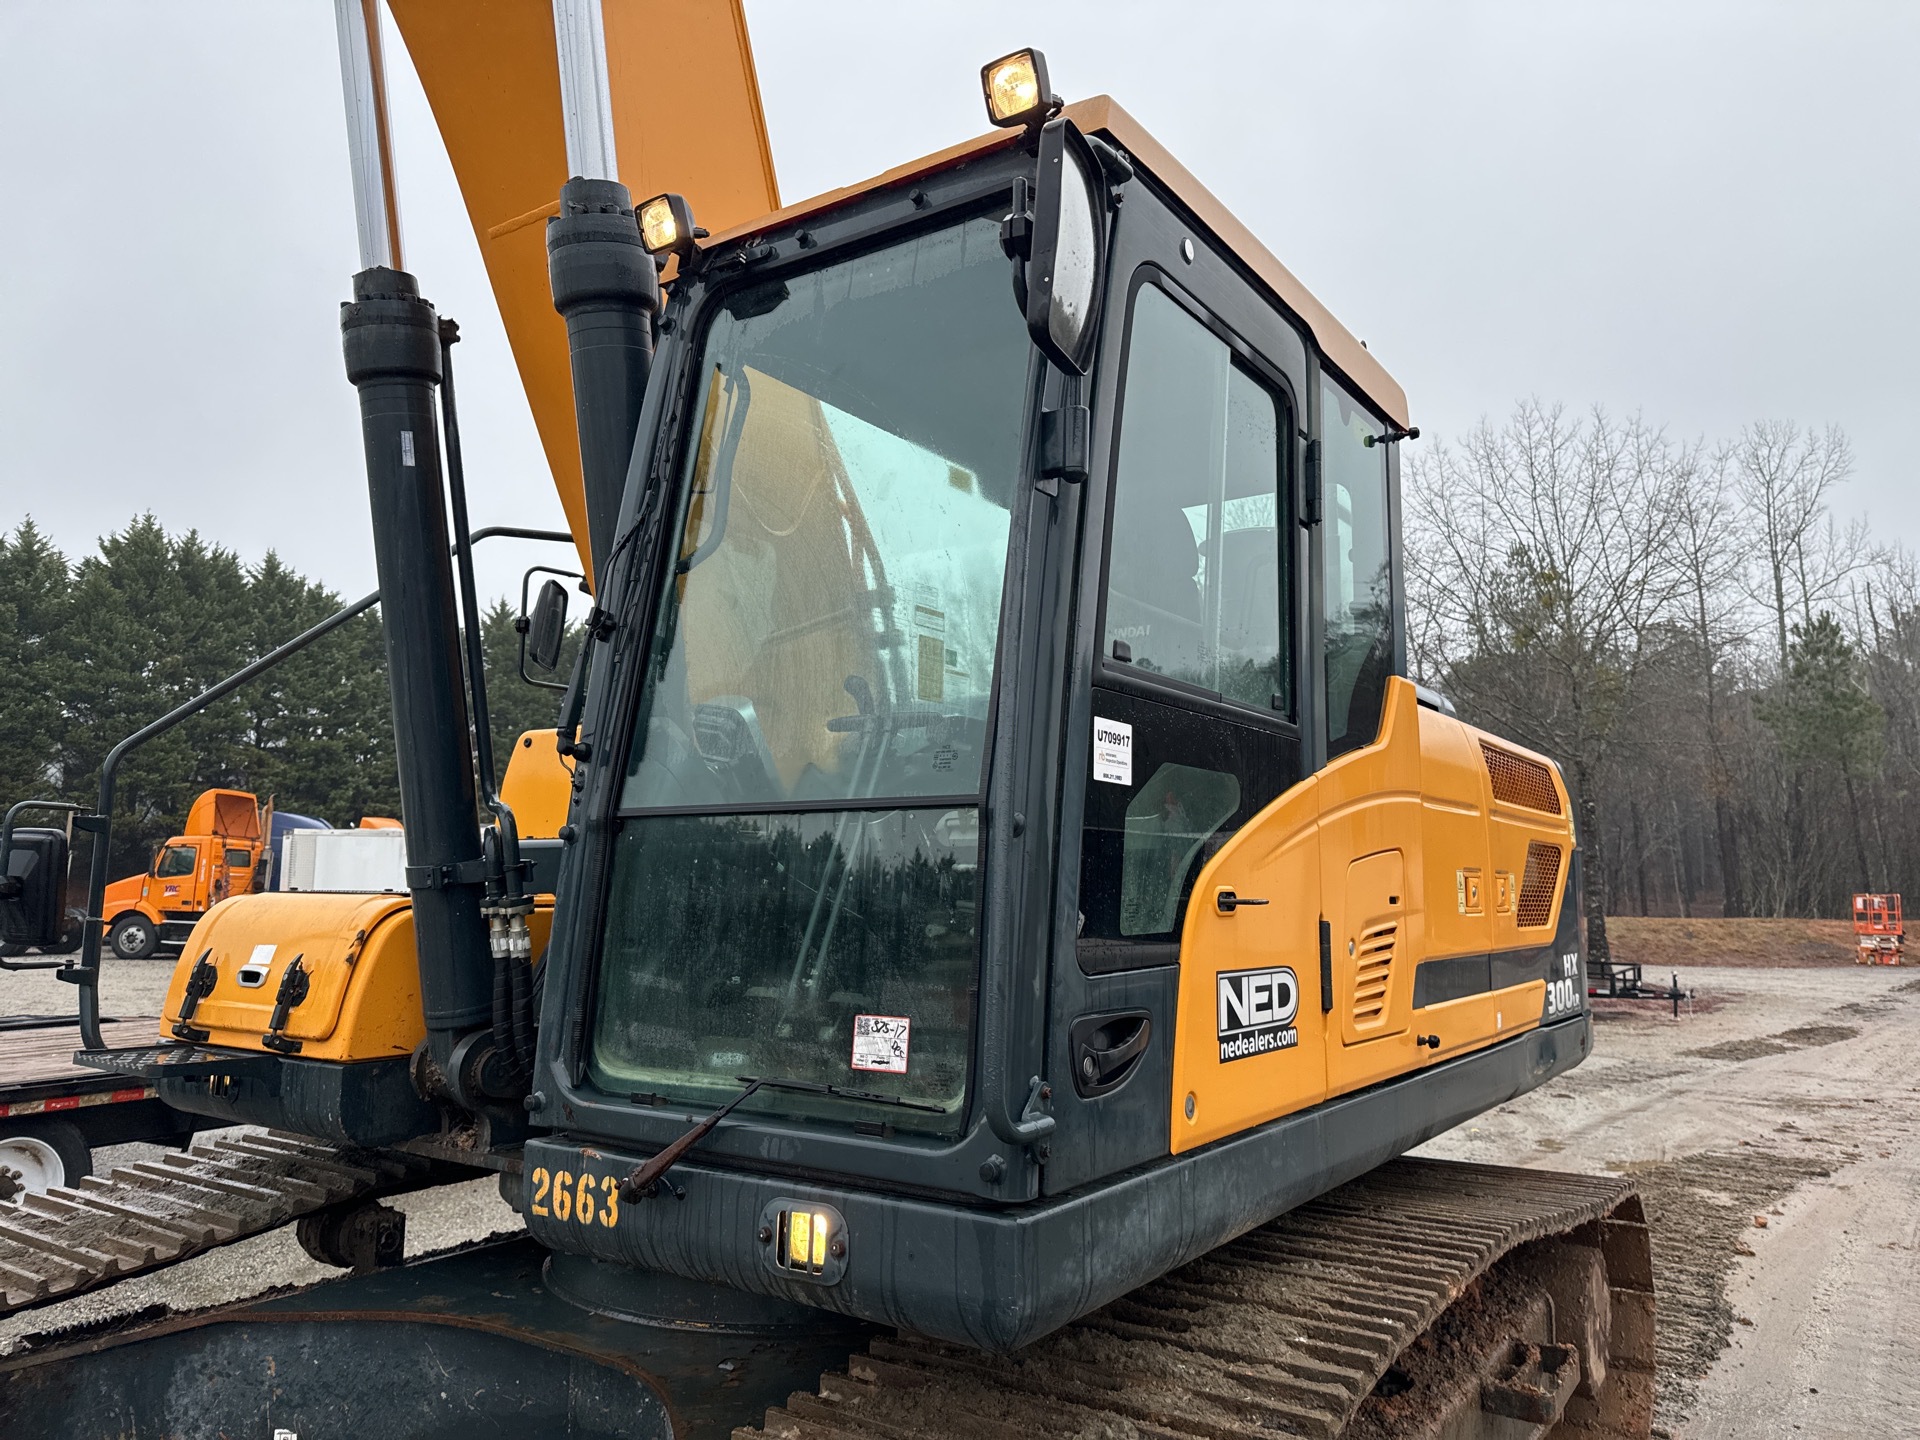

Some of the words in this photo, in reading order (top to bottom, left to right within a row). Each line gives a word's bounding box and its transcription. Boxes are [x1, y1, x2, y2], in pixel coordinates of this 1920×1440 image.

[1098, 729, 1130, 748] U709917
[164, 884, 181, 892] YRC
[1563, 953, 1578, 977] HX
[1219, 972, 1297, 1031] NED
[1220, 1028, 1297, 1060] nedealers.com
[531, 1166, 619, 1229] 2663
